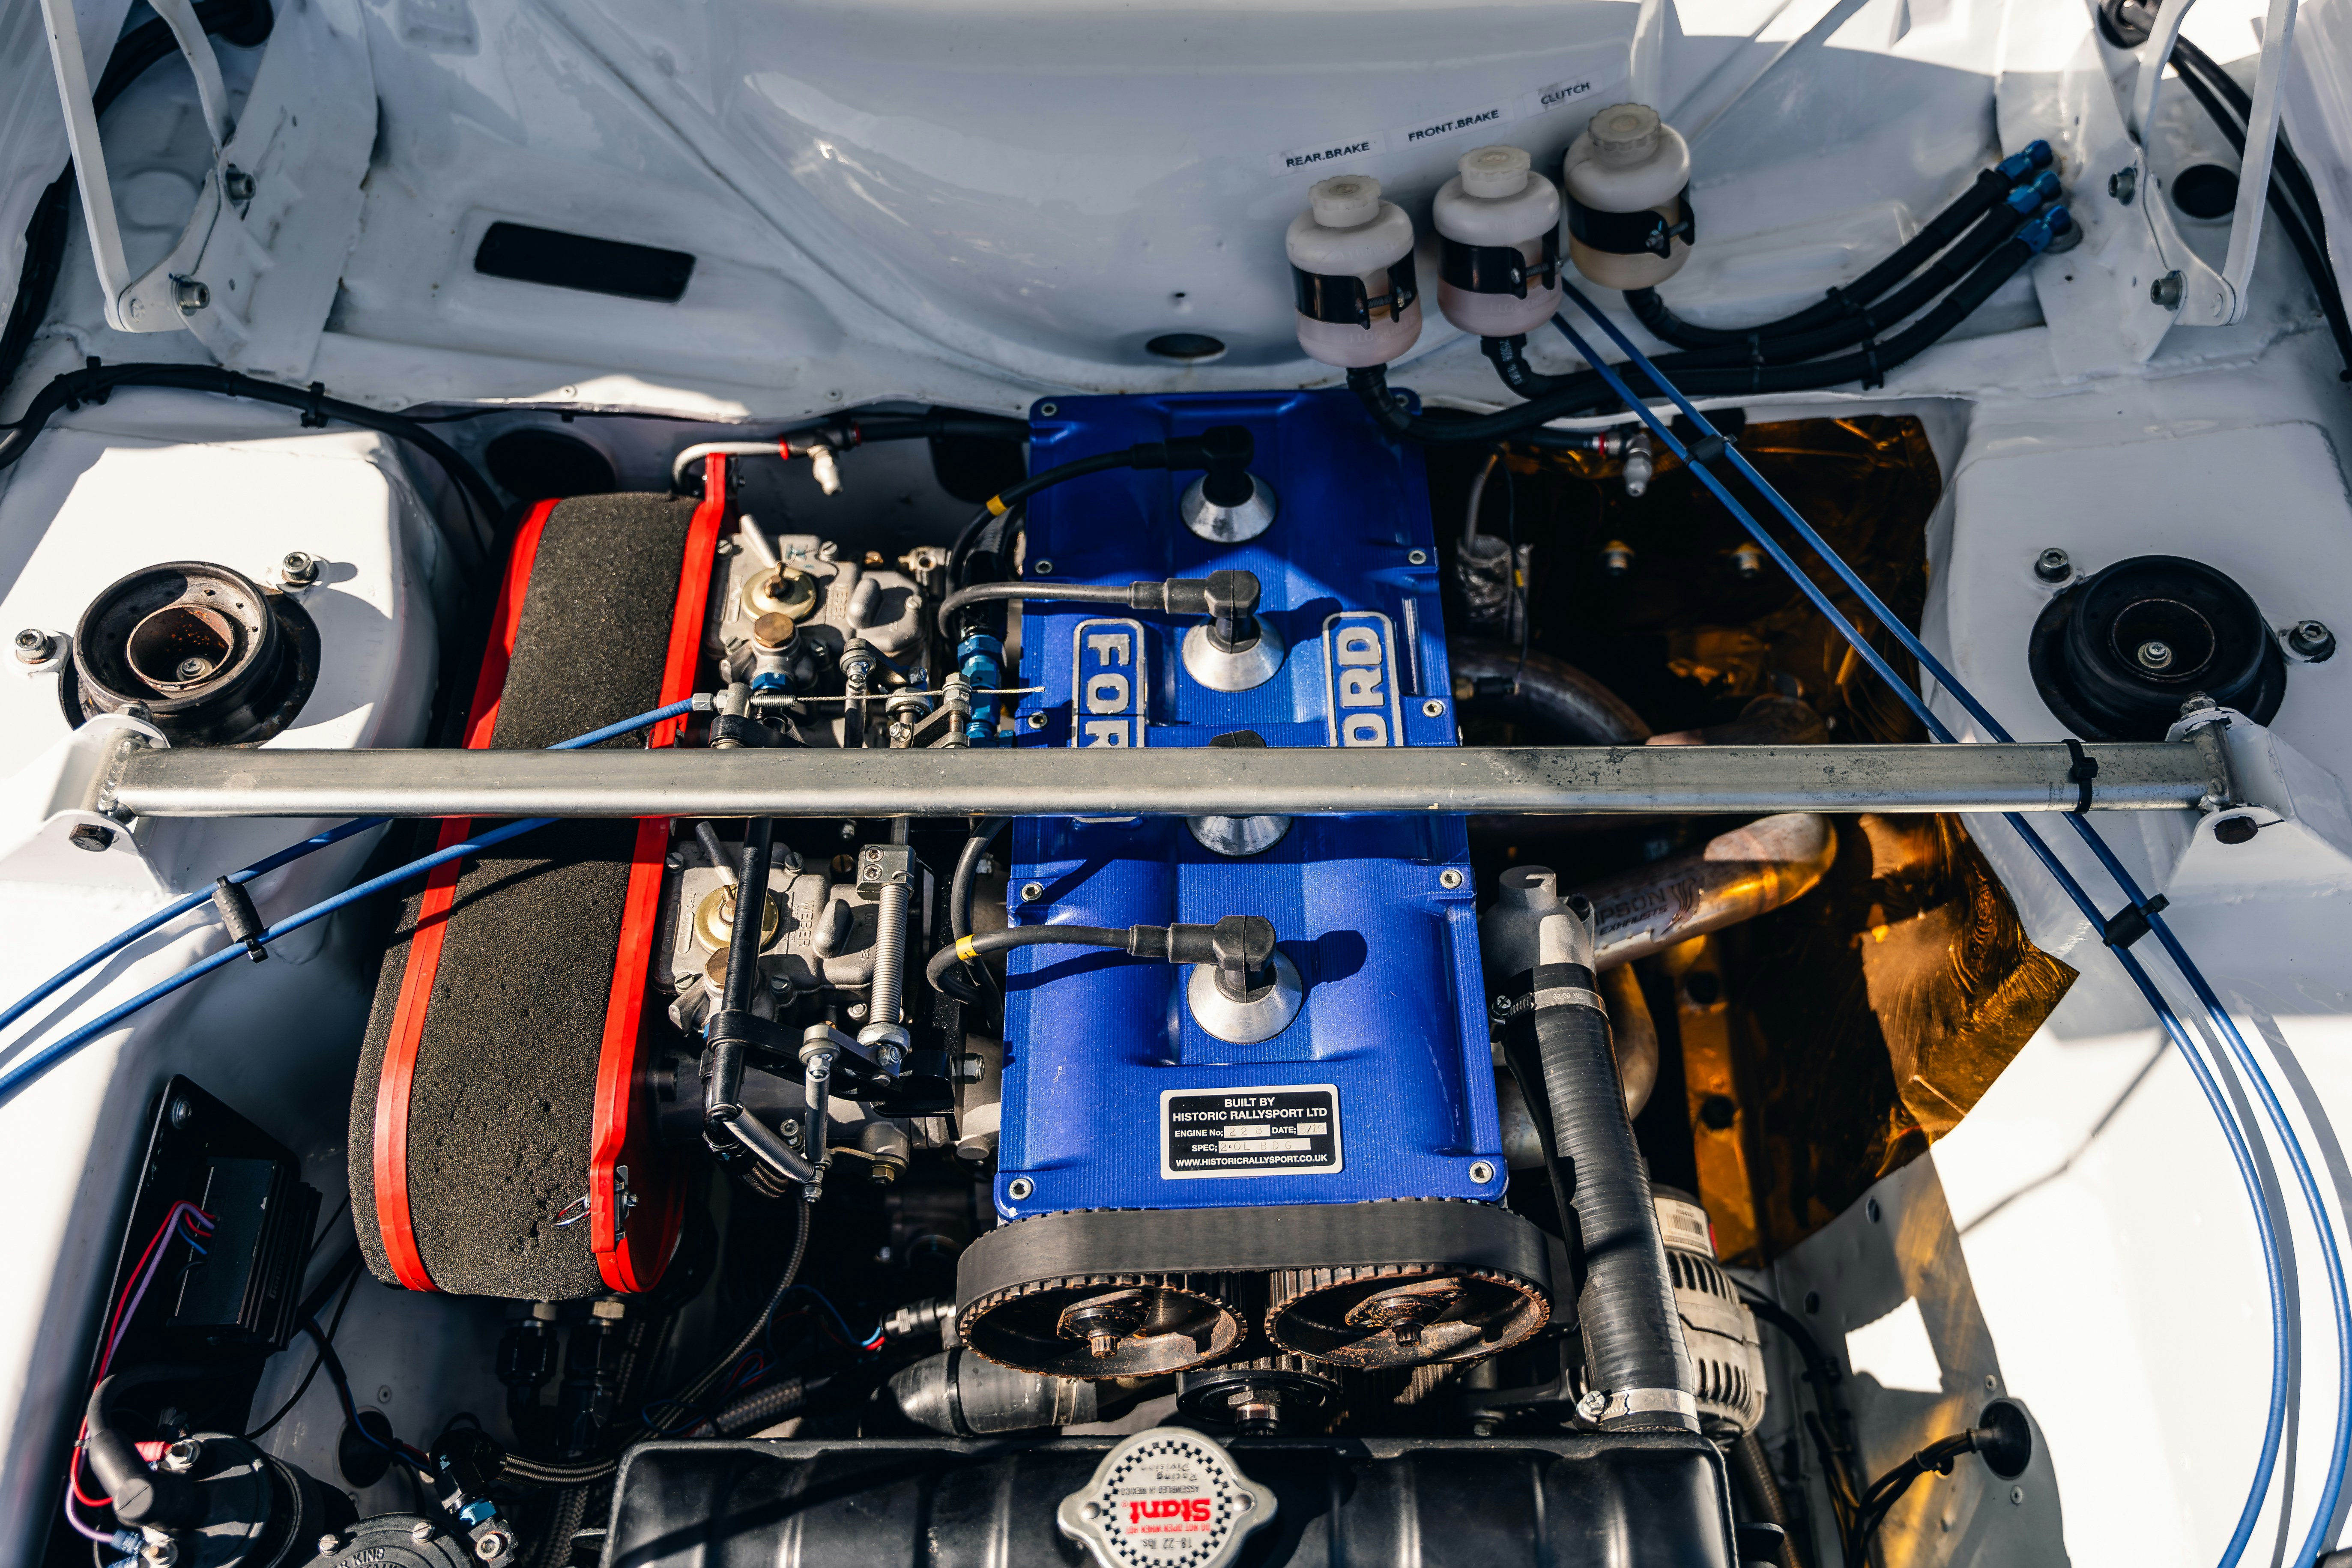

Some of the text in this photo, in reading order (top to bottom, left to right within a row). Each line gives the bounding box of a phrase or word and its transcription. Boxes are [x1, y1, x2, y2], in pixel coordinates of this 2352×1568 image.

[1540, 81, 1591, 105] CLUTCH
[1407, 109, 1500, 142] FRONT.BRAKE
[1285, 141, 1371, 168] REAR.BRAKE
[1085, 633, 1130, 748] FOR
[1338, 626, 1387, 747] ORD
[685, 893, 696, 909] TIPO
[796, 900, 815, 948] WEBER
[1599, 905, 1668, 936] EXHAUSTS
[1224, 1097, 1275, 1108] BUILT BY
[1172, 1108, 1327, 1122] HISTORIC RALLYSPORT LTD
[1175, 1129, 1207, 1138] ENGINE
[1300, 1124, 1325, 1134] 5/19
[1175, 1154, 1327, 1167] WWW.HISTORICRALLYSPORT.CO.UK
[1140, 1463, 1190, 1472] Division
[1156, 1471, 1198, 1482] Racing
[1121, 1487, 1147, 1495] MEXICO
[1158, 1485, 1199, 1494] ASSEMBLED
[1129, 1499, 1211, 1524] Stant
[1125, 1526, 1139, 1534] HOT
[1141, 1525, 1162, 1533] WHEN
[1163, 1537, 1193, 1549] 18-22
[352, 1547, 386, 1566] KING
